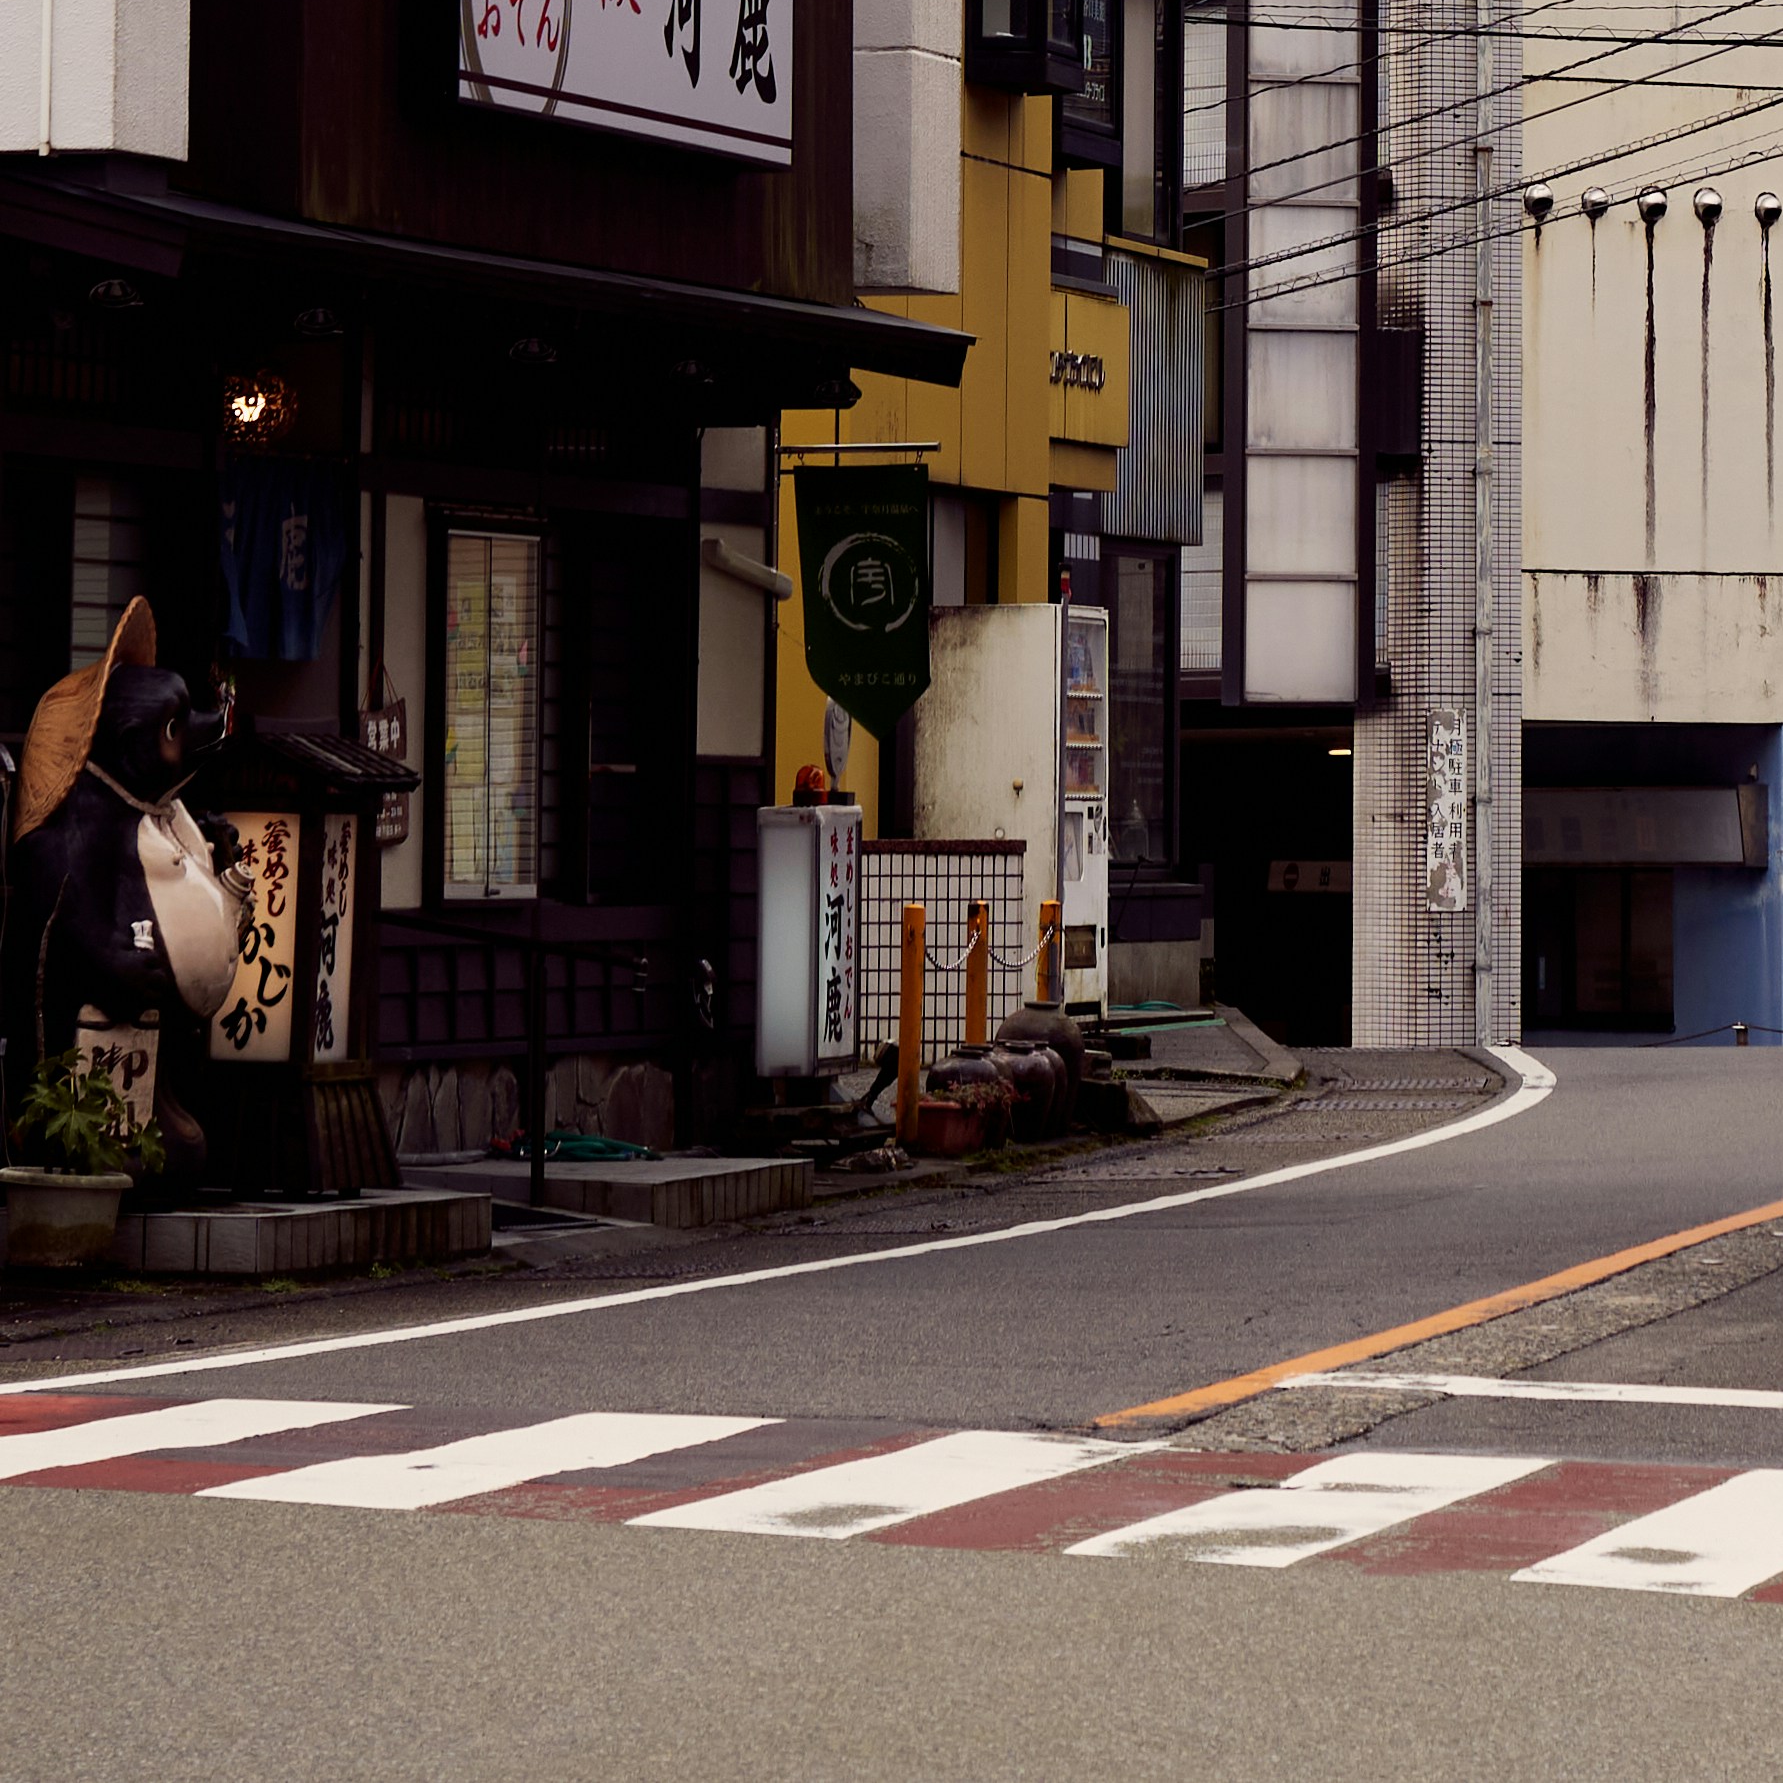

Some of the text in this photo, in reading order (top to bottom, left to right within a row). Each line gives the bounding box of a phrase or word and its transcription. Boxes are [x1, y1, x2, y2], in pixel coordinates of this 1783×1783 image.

[837, 670, 918, 688] やまびこ通り
[262, 820, 291, 917] 釜めし
[823, 892, 845, 1044] 河鹿
